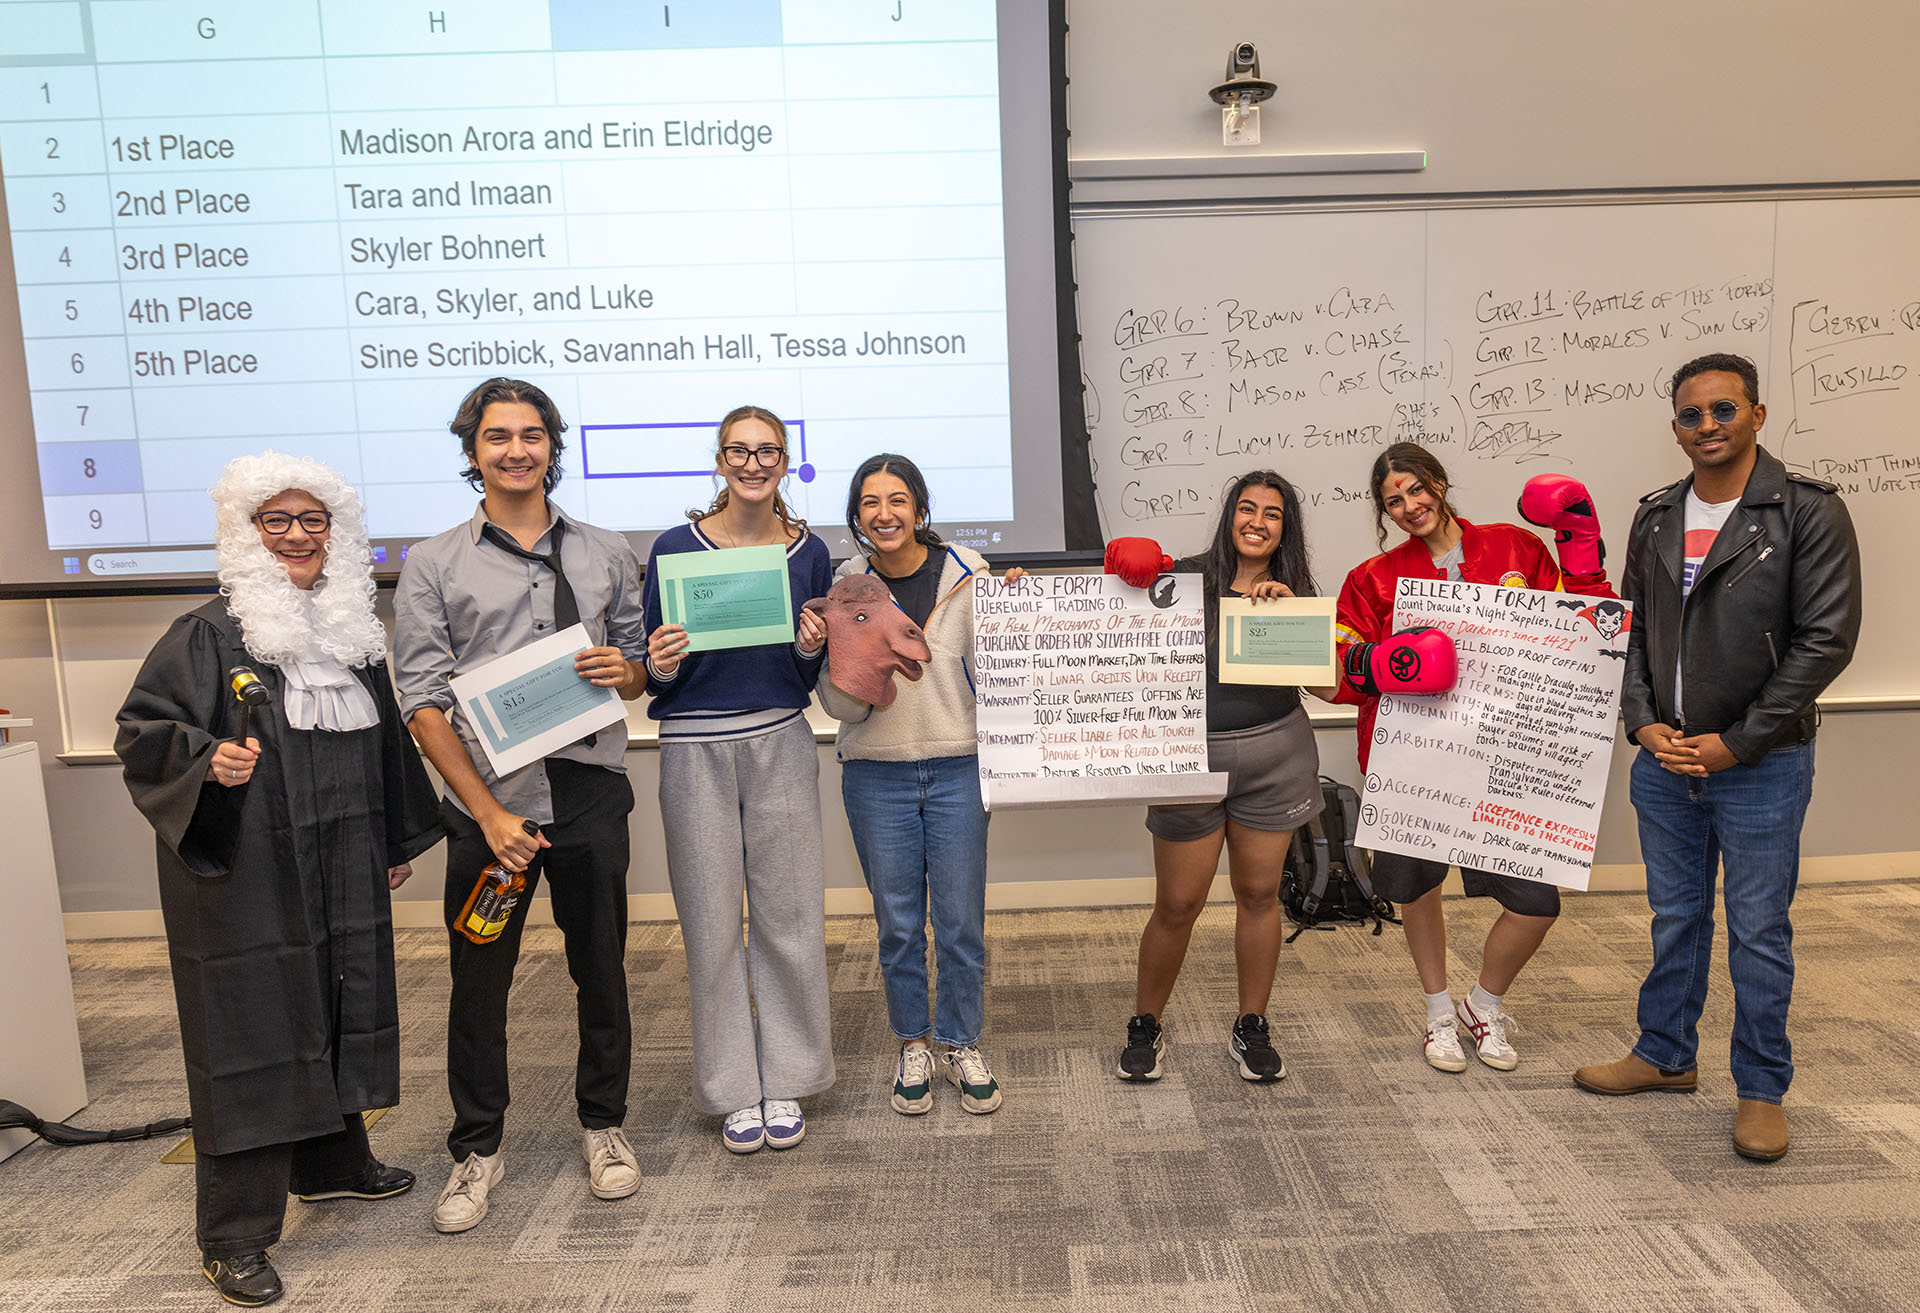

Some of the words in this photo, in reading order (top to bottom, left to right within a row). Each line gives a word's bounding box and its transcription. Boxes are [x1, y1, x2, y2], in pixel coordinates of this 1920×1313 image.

[664, 5, 670, 27] I
[891, 0, 902, 22] J
[197, 18, 217, 40] G
[429, 12, 446, 34] H
[40, 83, 51, 104] 1
[46, 138, 60, 159] 2
[111, 136, 151, 162] 1st
[160, 134, 235, 160] Place
[340, 127, 452, 155] Madison
[463, 126, 535, 152] Arora
[544, 124, 592, 150] and
[602, 122, 654, 148] Erin
[664, 120, 773, 151] Eldridge
[52, 192, 66, 213] 3
[116, 190, 165, 217] 2nd
[176, 188, 250, 215] Place
[344, 183, 402, 209] Tara
[412, 181, 460, 207] and
[470, 180, 552, 206] Imaan
[58, 246, 72, 267] 4
[122, 245, 164, 270] 3rd
[176, 243, 249, 268] Place
[350, 236, 432, 268] Skyler
[442, 233, 545, 260] Bohnert
[65, 300, 78, 321] 5
[128, 299, 169, 324] 4th
[179, 296, 253, 322] Place
[355, 291, 427, 318] Cara,
[436, 287, 523, 319] Skyler,
[533, 285, 580, 311] and
[591, 284, 654, 309] Luke
[1573, 290, 1644, 320] BATTLE
[1652, 292, 1673, 308] OF
[1675, 285, 1714, 306] THE
[1217, 299, 1303, 333] BROWN
[1325, 323, 1410, 356] CHASE
[1563, 328, 1650, 353] MORALES
[1681, 309, 1724, 341] SUN
[360, 344, 418, 369] Sine
[427, 340, 555, 369] Scribbick,
[563, 336, 695, 363] Savannah
[704, 334, 762, 363] Hall,
[770, 332, 847, 358] Tessa
[856, 331, 966, 357] Johnson
[71, 353, 84, 374] 6
[134, 352, 175, 377] 5th
[184, 350, 258, 376] Place
[1228, 379, 1306, 412] MASON
[1319, 370, 1370, 396] CASE
[1566, 380, 1644, 406] MASON
[76, 405, 89, 426] 7
[1398, 419, 1425, 432] THE
[1216, 425, 1274, 457] LUCY
[1304, 425, 1383, 449] ZEHMER
[83, 458, 97, 479] 8
[1819, 458, 1873, 475] DON'T
[1868, 476, 1906, 493] VOTE
[88, 509, 102, 530] 9
[956, 528, 974, 537] 12:51
[976, 528, 987, 536] PM
[111, 560, 138, 568] Search
[693, 589, 713, 601] $50
[976, 577, 1044, 597] BUYER'S
[1053, 576, 1103, 596] FORM
[1400, 579, 1481, 601] SELLER'S
[1495, 589, 1546, 612] FORM
[976, 599, 1043, 614] WEREWOLF
[1046, 597, 1105, 613] TRADING
[1109, 597, 1127, 611] CO.
[1396, 598, 1423, 611] Count
[1427, 600, 1471, 613] Dracula's
[1476, 605, 1506, 623] Night
[1554, 618, 1580, 632] LLC
[1003, 617, 1030, 633] REAL
[1033, 614, 1101, 633] MERCHANTS
[1107, 615, 1125, 630] OF
[1128, 615, 1146, 630] THE
[1149, 613, 1168, 629] FULL
[1249, 627, 1267, 637] $25
[1456, 620, 1508, 638] Darkness
[1512, 631, 1538, 644] since
[976, 634, 1031, 652] PURCHASE
[1035, 634, 1070, 650] ORDER
[1073, 632, 1093, 649] FOR
[1096, 631, 1161, 648] SILVER-FREE
[1166, 630, 1205, 647] COFFINS
[1033, 654, 1055, 669] FULL
[1057, 655, 1086, 668] MOON
[1148, 652, 1167, 665] TIME
[1479, 642, 1515, 657] BLOOD
[1517, 649, 1552, 663] PROOF
[1552, 657, 1596, 674] COFFINS
[1050, 671, 1084, 686] LUNAR
[1091, 670, 1132, 684] CREDITS
[1136, 669, 1157, 682] UPON
[1164, 669, 1202, 682] RECEIPT
[1497, 664, 1518, 677] FOB
[1518, 670, 1542, 683] Castle
[1033, 689, 1069, 706] SELLER
[1074, 690, 1134, 704] GUARANTEES
[1142, 687, 1182, 702] COFFINS
[1186, 686, 1204, 700] ARE
[1497, 675, 1534, 690] midnight
[1550, 688, 1573, 698] avoid
[502, 692, 525, 711] $15
[1149, 705, 1177, 720] MOON
[1181, 705, 1202, 719] SAFE
[1517, 692, 1535, 703] Due
[1546, 697, 1566, 709] blood
[1568, 705, 1593, 717] within
[1040, 726, 1077, 744] SELLER
[1081, 727, 1112, 742] LIABLE
[1119, 726, 1138, 740] FOR
[1141, 725, 1157, 739] ALL
[1158, 725, 1194, 738] TOURCH
[1478, 722, 1507, 736] Buyer
[1509, 731, 1544, 746] assumes
[1546, 720, 1578, 735] sunlight
[1038, 745, 1080, 761] DAMAGE
[1163, 742, 1205, 756] CHANGES
[1390, 730, 1490, 762] ARBITRATION:
[1137, 761, 1167, 774] UNDER
[1170, 760, 1200, 773] LUNAR
[1494, 754, 1535, 773] Disputes
[1536, 768, 1570, 782] resolved
[1531, 787, 1554, 799] Rules
[1566, 795, 1596, 810] Eternal
[1552, 783, 1577, 794] under
[1383, 778, 1471, 808] ACCEPTANCE:
[1475, 800, 1543, 828] ACCEPTANCE
[1380, 808, 1451, 835] GOVERNING
[1482, 832, 1511, 848] DARK
[1512, 841, 1530, 853] CODE
[1472, 811, 1520, 832] LIMITED
[1379, 825, 1437, 849] SIGNED,
[1448, 847, 1488, 868] COUNT
[1492, 857, 1544, 878] TARCULA
